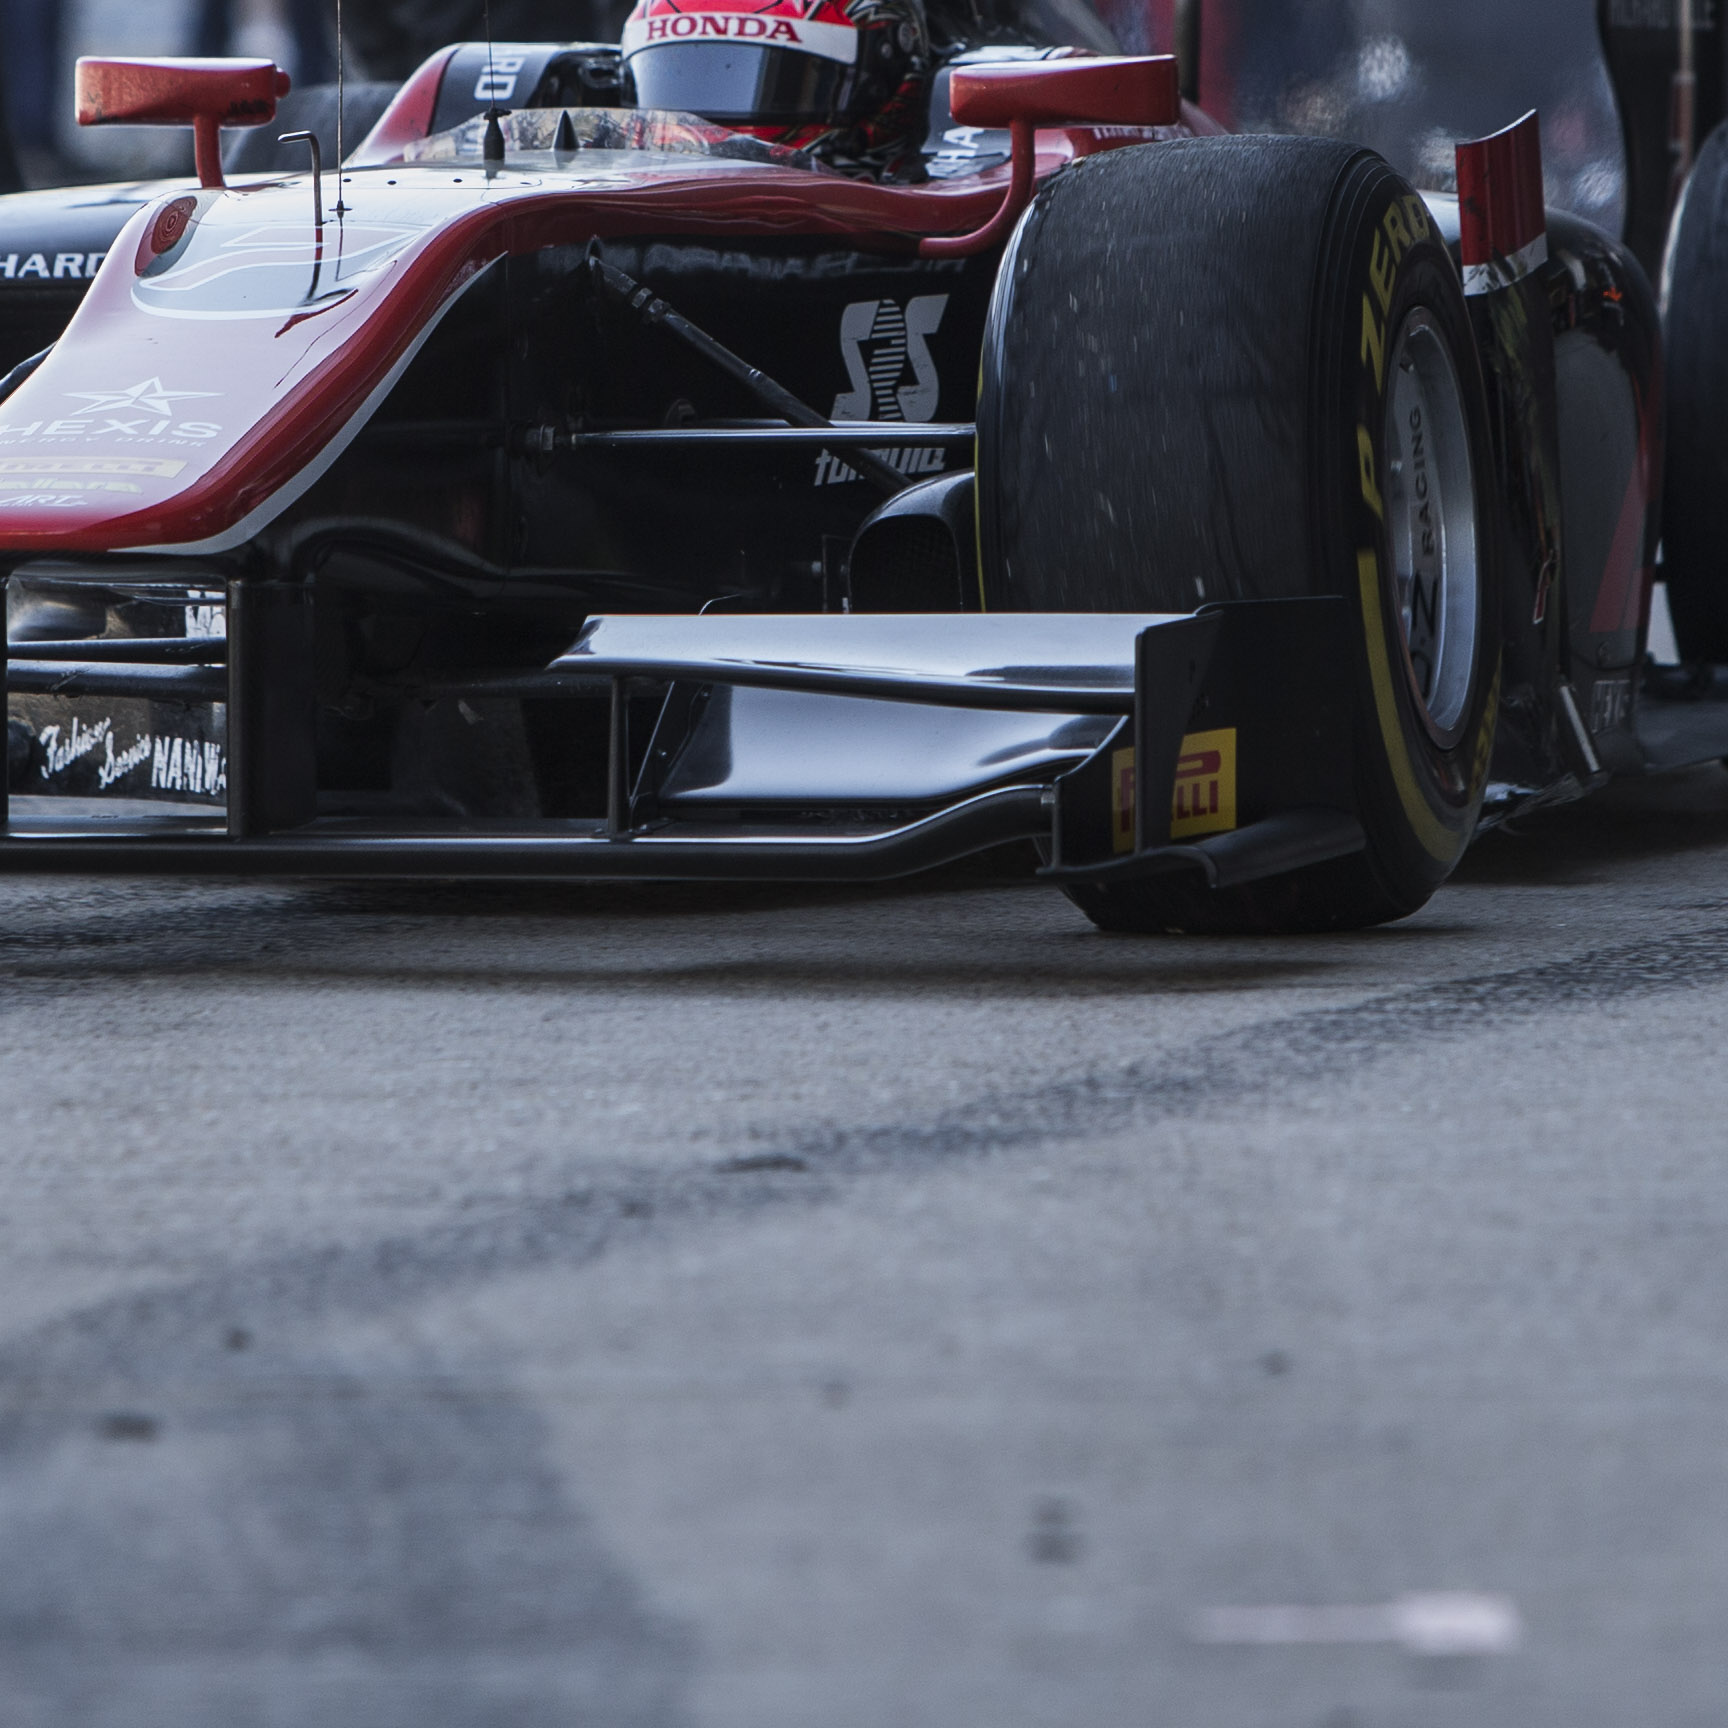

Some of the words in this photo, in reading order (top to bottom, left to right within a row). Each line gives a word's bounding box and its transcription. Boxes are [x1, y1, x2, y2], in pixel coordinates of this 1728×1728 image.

[646, 15, 803, 43] HONDA
[1360, 193, 1432, 397] ZERO
[1409, 406, 1436, 557] RACING
